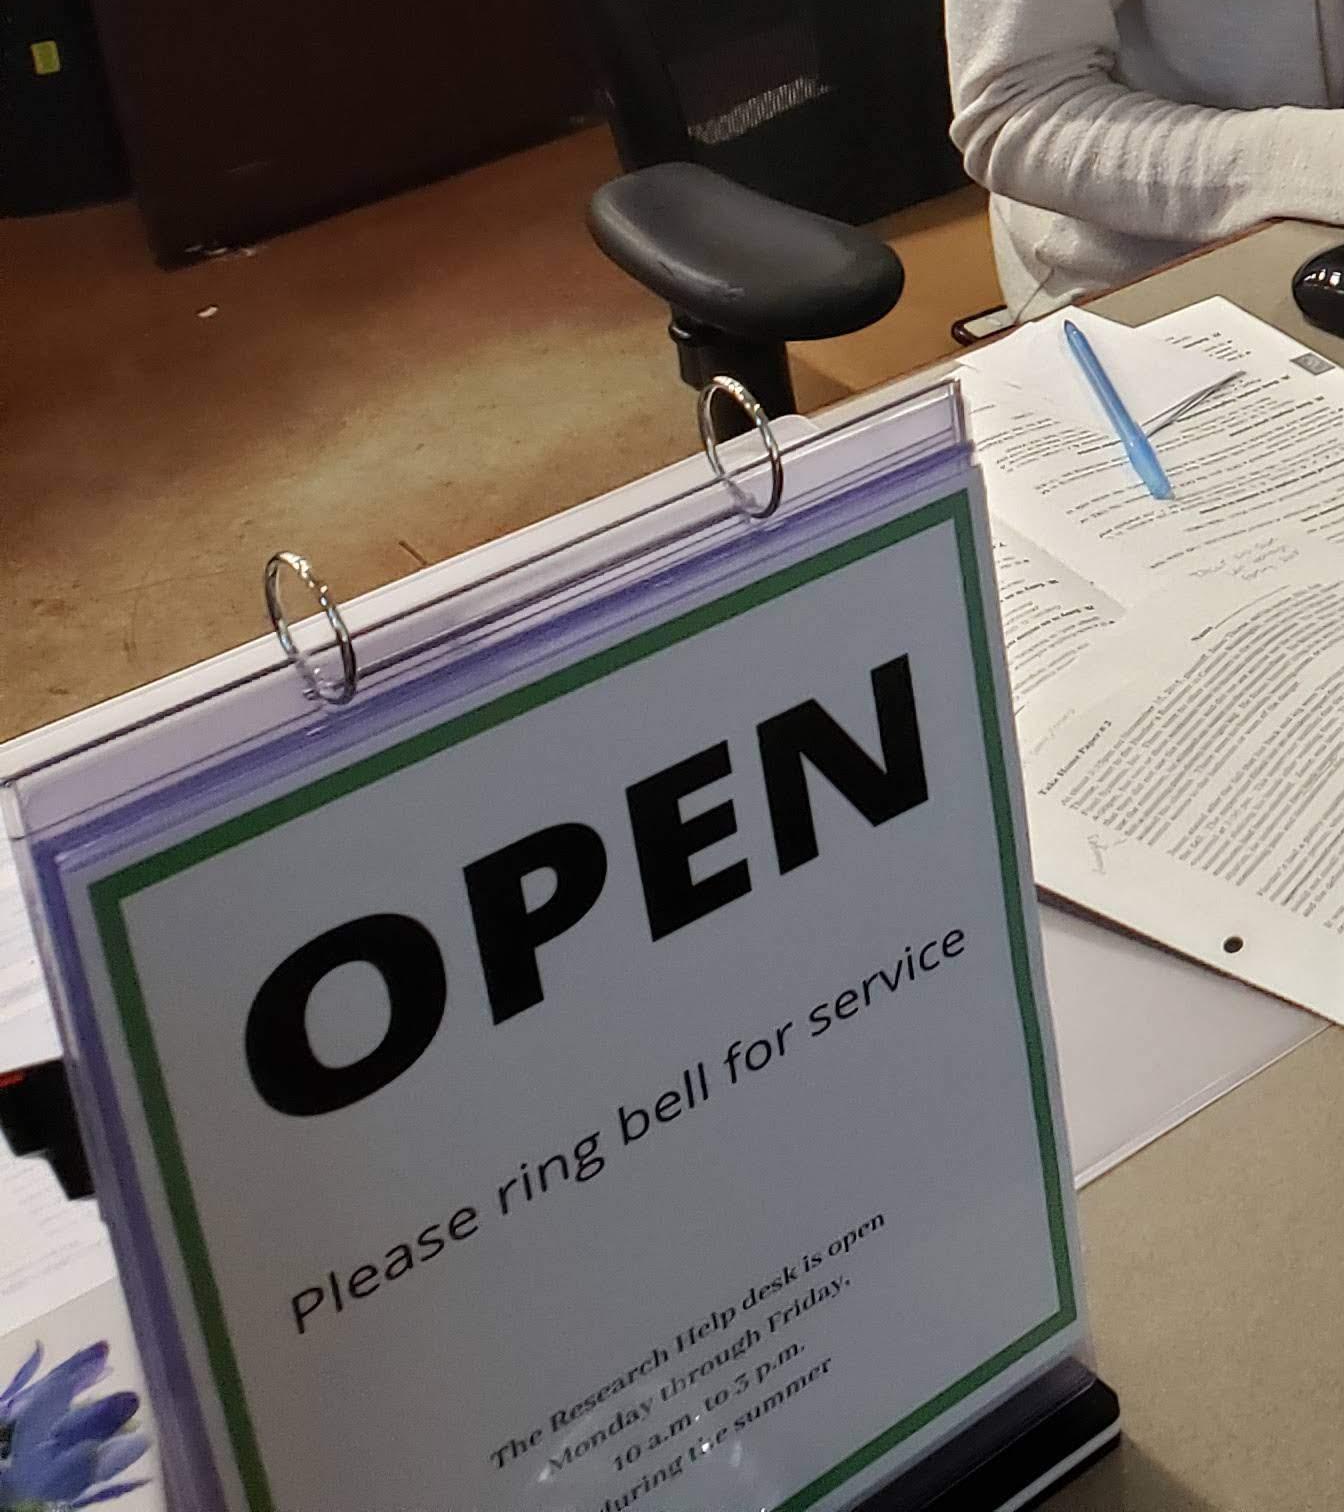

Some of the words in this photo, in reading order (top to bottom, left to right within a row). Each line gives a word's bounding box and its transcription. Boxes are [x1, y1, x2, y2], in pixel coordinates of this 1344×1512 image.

[244, 653, 929, 1118] OPEN
[290, 1205, 480, 1335] Please
[497, 1131, 607, 1216] ring
[618, 1062, 710, 1145] bell
[722, 1021, 794, 1084] for
[809, 928, 966, 1038] service
[489, 1427, 544, 1471] The
[549, 1348, 670, 1434] Research
[675, 1307, 737, 1352] Help
[742, 1265, 798, 1311] desk
[802, 1253, 823, 1274] is
[827, 1213, 886, 1258] open
[546, 1397, 655, 1475] Monday
[659, 1328, 762, 1404] through
[613, 1444, 641, 1472] 10
[703, 1387, 728, 1413] to
[755, 1343, 805, 1386] p.m.
[733, 1355, 833, 1432] summer
